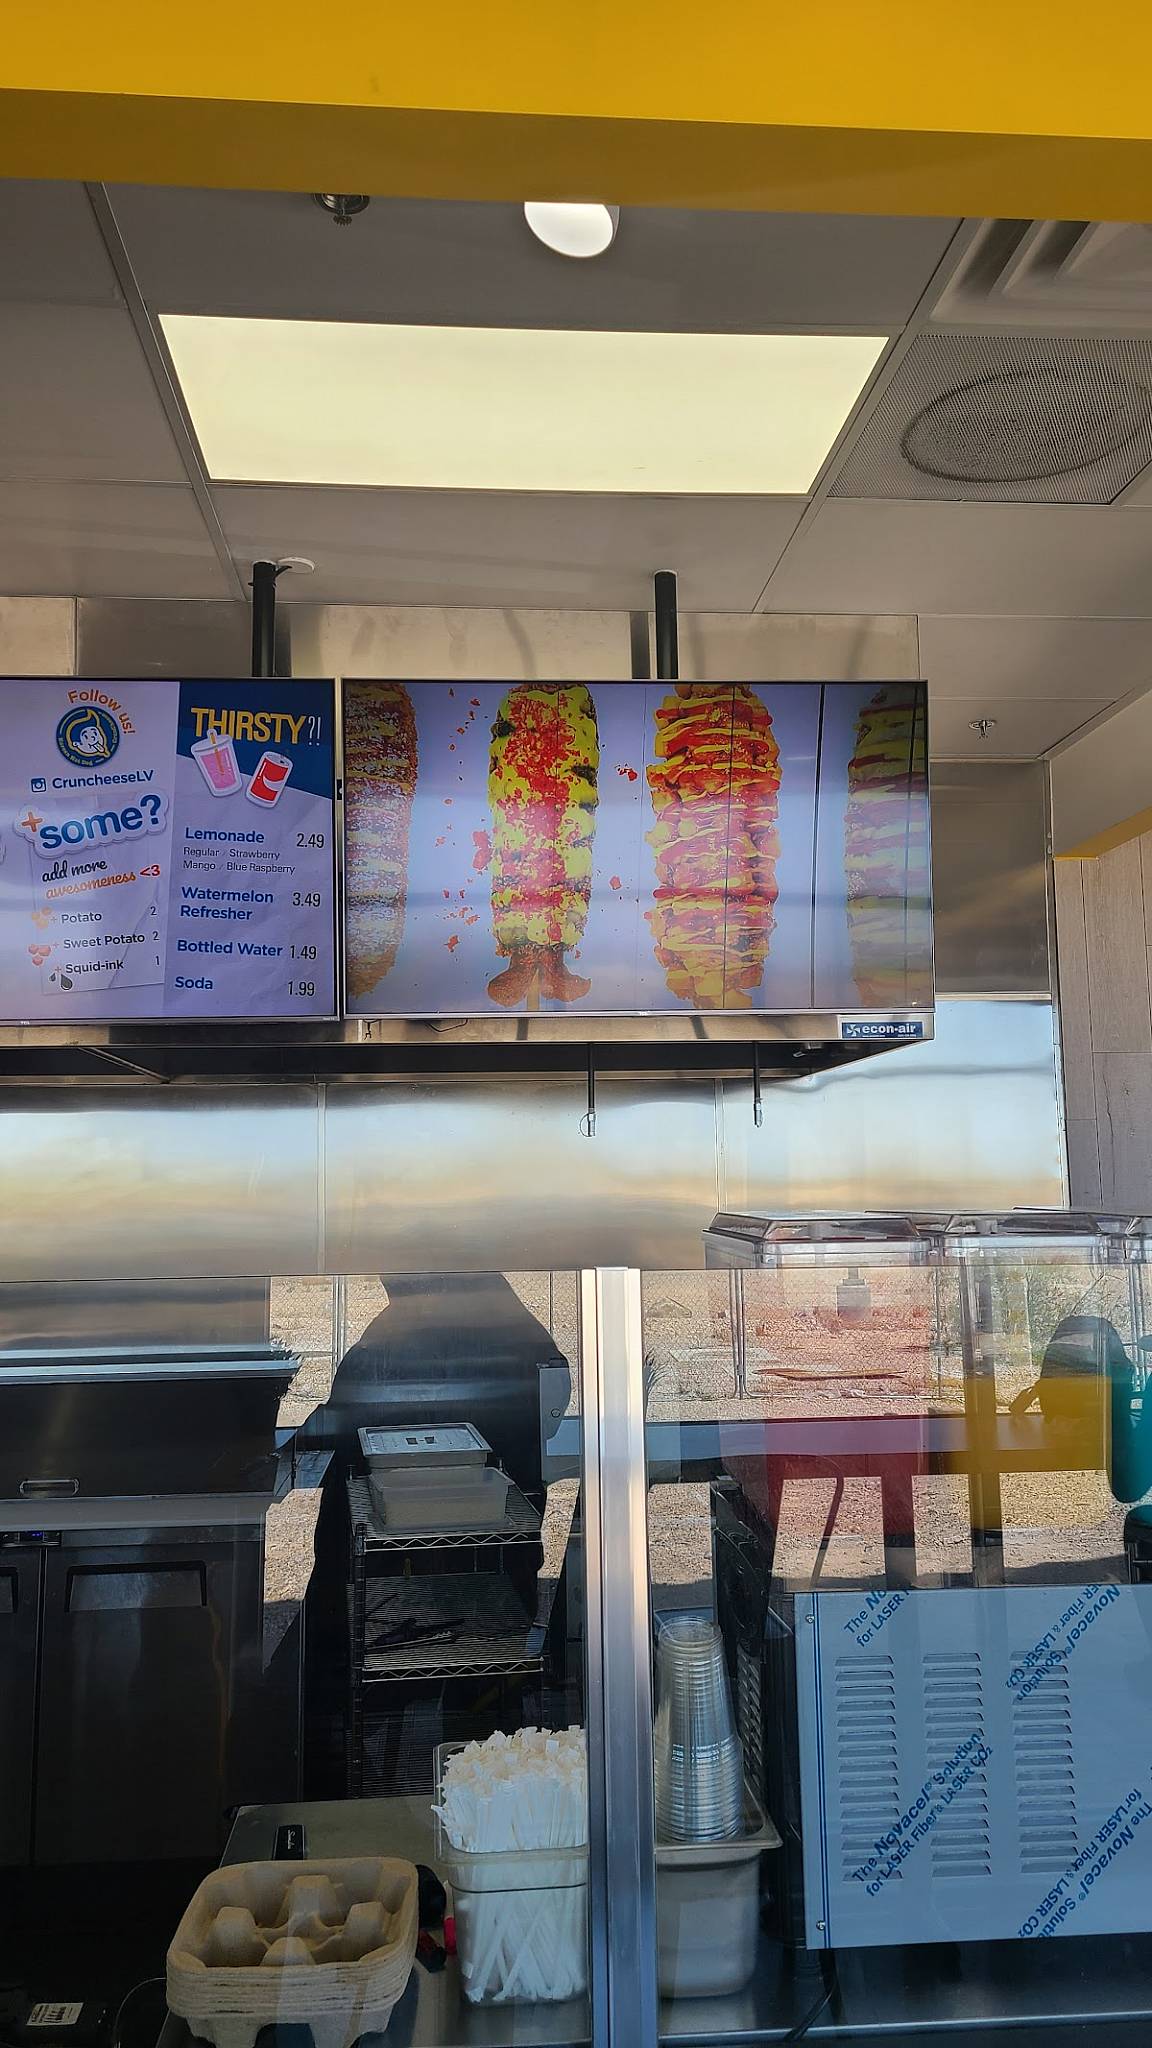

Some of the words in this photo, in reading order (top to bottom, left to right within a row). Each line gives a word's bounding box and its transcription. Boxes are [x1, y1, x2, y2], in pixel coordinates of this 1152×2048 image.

[68, 689, 121, 711] Follow
[118, 713, 136, 735] us!
[52, 770, 154, 789] CruncheeseLV
[185, 827, 265, 843] Lemonade
[296, 833, 325, 849] 2.49
[183, 847, 220, 857] Regular
[229, 849, 280, 861] Strawberry
[42, 860, 68, 882] add
[71, 861, 108, 877] more
[183, 860, 216, 871] Mango
[226, 862, 248, 871] Blue
[249, 863, 295, 875] Raspberry
[46, 872, 137, 899] awesomeness
[181, 886, 274, 903] Watermelon
[292, 892, 321, 907] 3.49
[61, 912, 102, 924] Potato
[150, 906, 157, 915] 2
[180, 905, 253, 920] Refresher
[63, 937, 101, 949] Sweet
[104, 934, 145, 945] Potato
[152, 931, 160, 940] 2
[177, 939, 233, 954] Bottled
[237, 942, 283, 957] Water
[290, 945, 317, 960] 1.49
[66, 960, 124, 974] Squid-ink
[155, 956, 160, 965] 1
[175, 976, 213, 989] Soda
[288, 981, 315, 996] 1.99
[844, 1610, 868, 1633] The
[857, 1628, 873, 1647] for
[871, 1594, 904, 1630] LASER
[1060, 1598, 1085, 1627] Fiber
[1022, 1632, 1057, 1668] LASER
[1016, 1651, 1062, 1701] Solution
[852, 1857, 877, 1882] The
[933, 1733, 982, 1786] Solution
[1126, 1788, 1142, 1808] for
[1095, 1806, 1128, 1843] LASER
[1131, 1802, 1152, 1826] The
[866, 1876, 884, 1897] for
[879, 1840, 915, 1879] LASER
[911, 1810, 938, 1843] Fiber
[941, 1766, 975, 1805] LASER
[1072, 1841, 1099, 1872] Fiber
[1036, 1878, 1070, 1916] LASER
